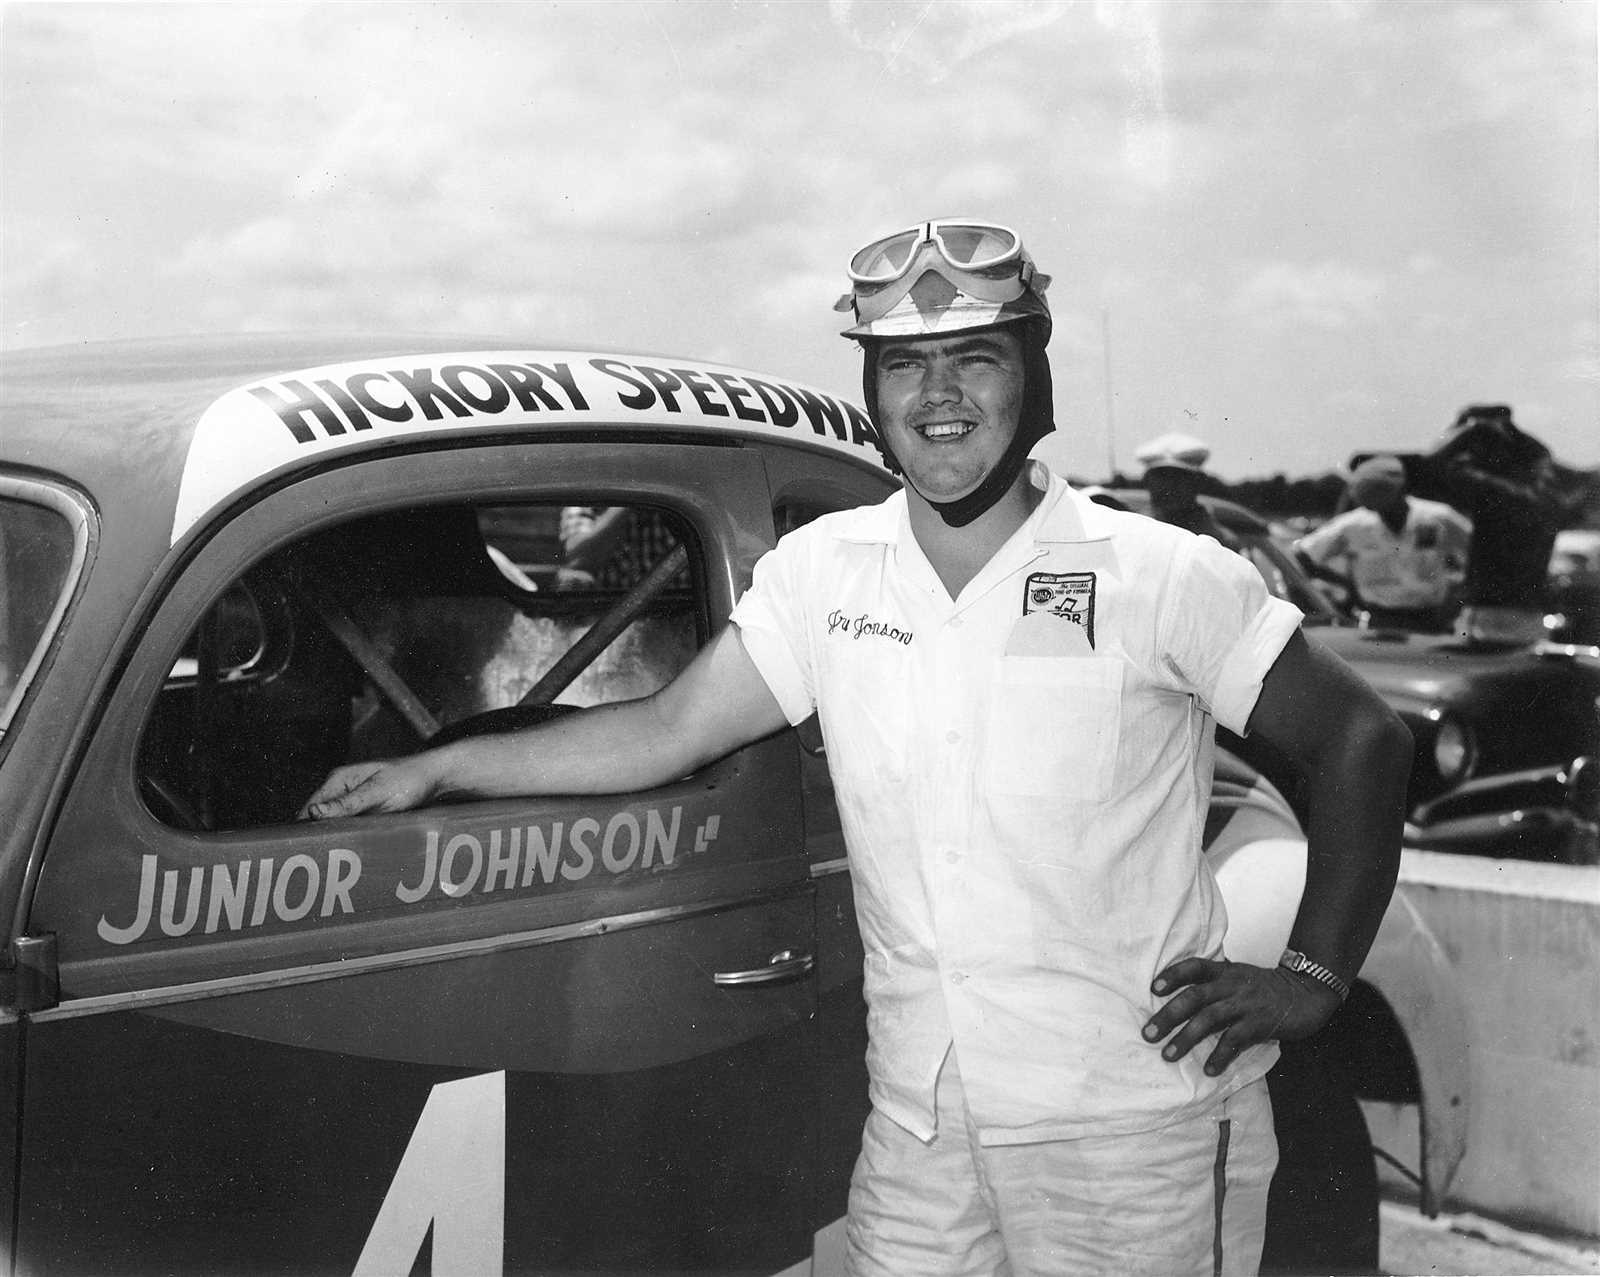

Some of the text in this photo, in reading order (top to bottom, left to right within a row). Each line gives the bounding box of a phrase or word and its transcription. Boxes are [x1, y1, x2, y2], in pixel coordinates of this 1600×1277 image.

[251, 358, 880, 449] HICKORY SPEEDWA
[853, 614, 913, 645] Jonson
[97, 805, 683, 945] JUNIOR JOHNSON
